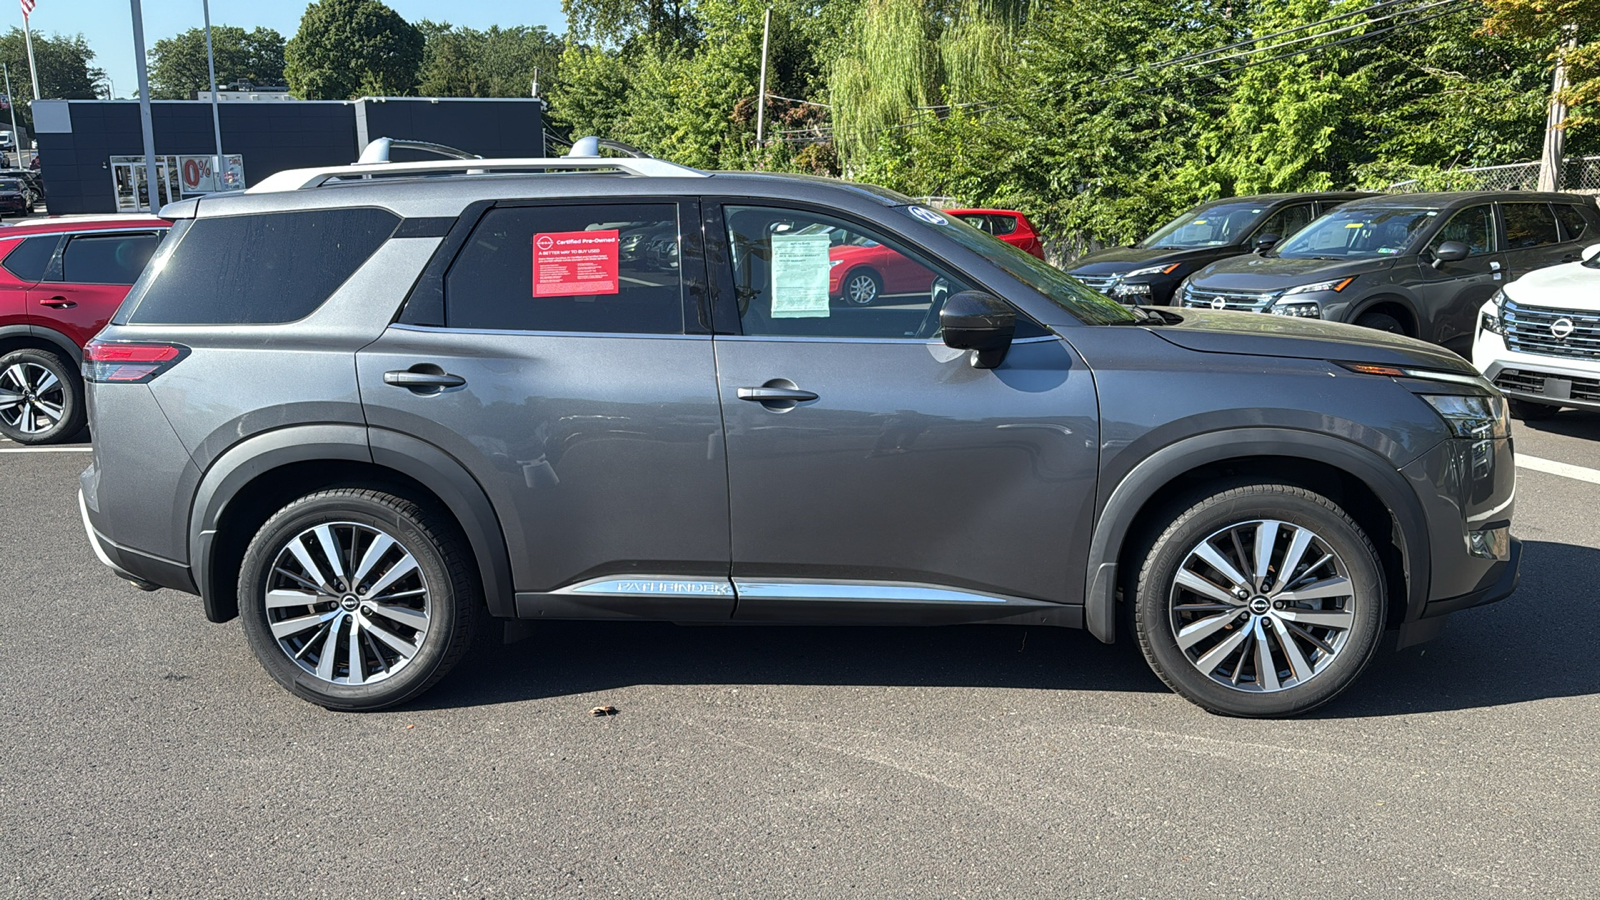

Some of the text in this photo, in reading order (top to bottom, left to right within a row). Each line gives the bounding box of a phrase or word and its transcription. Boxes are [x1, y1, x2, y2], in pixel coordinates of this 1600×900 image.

[184, 159, 211, 187] 0%
[404, 528, 447, 591] BRIDGESTONE
[1146, 546, 1175, 618] BRIDGESTONE
[616, 582, 728, 595] PATHFINDER
